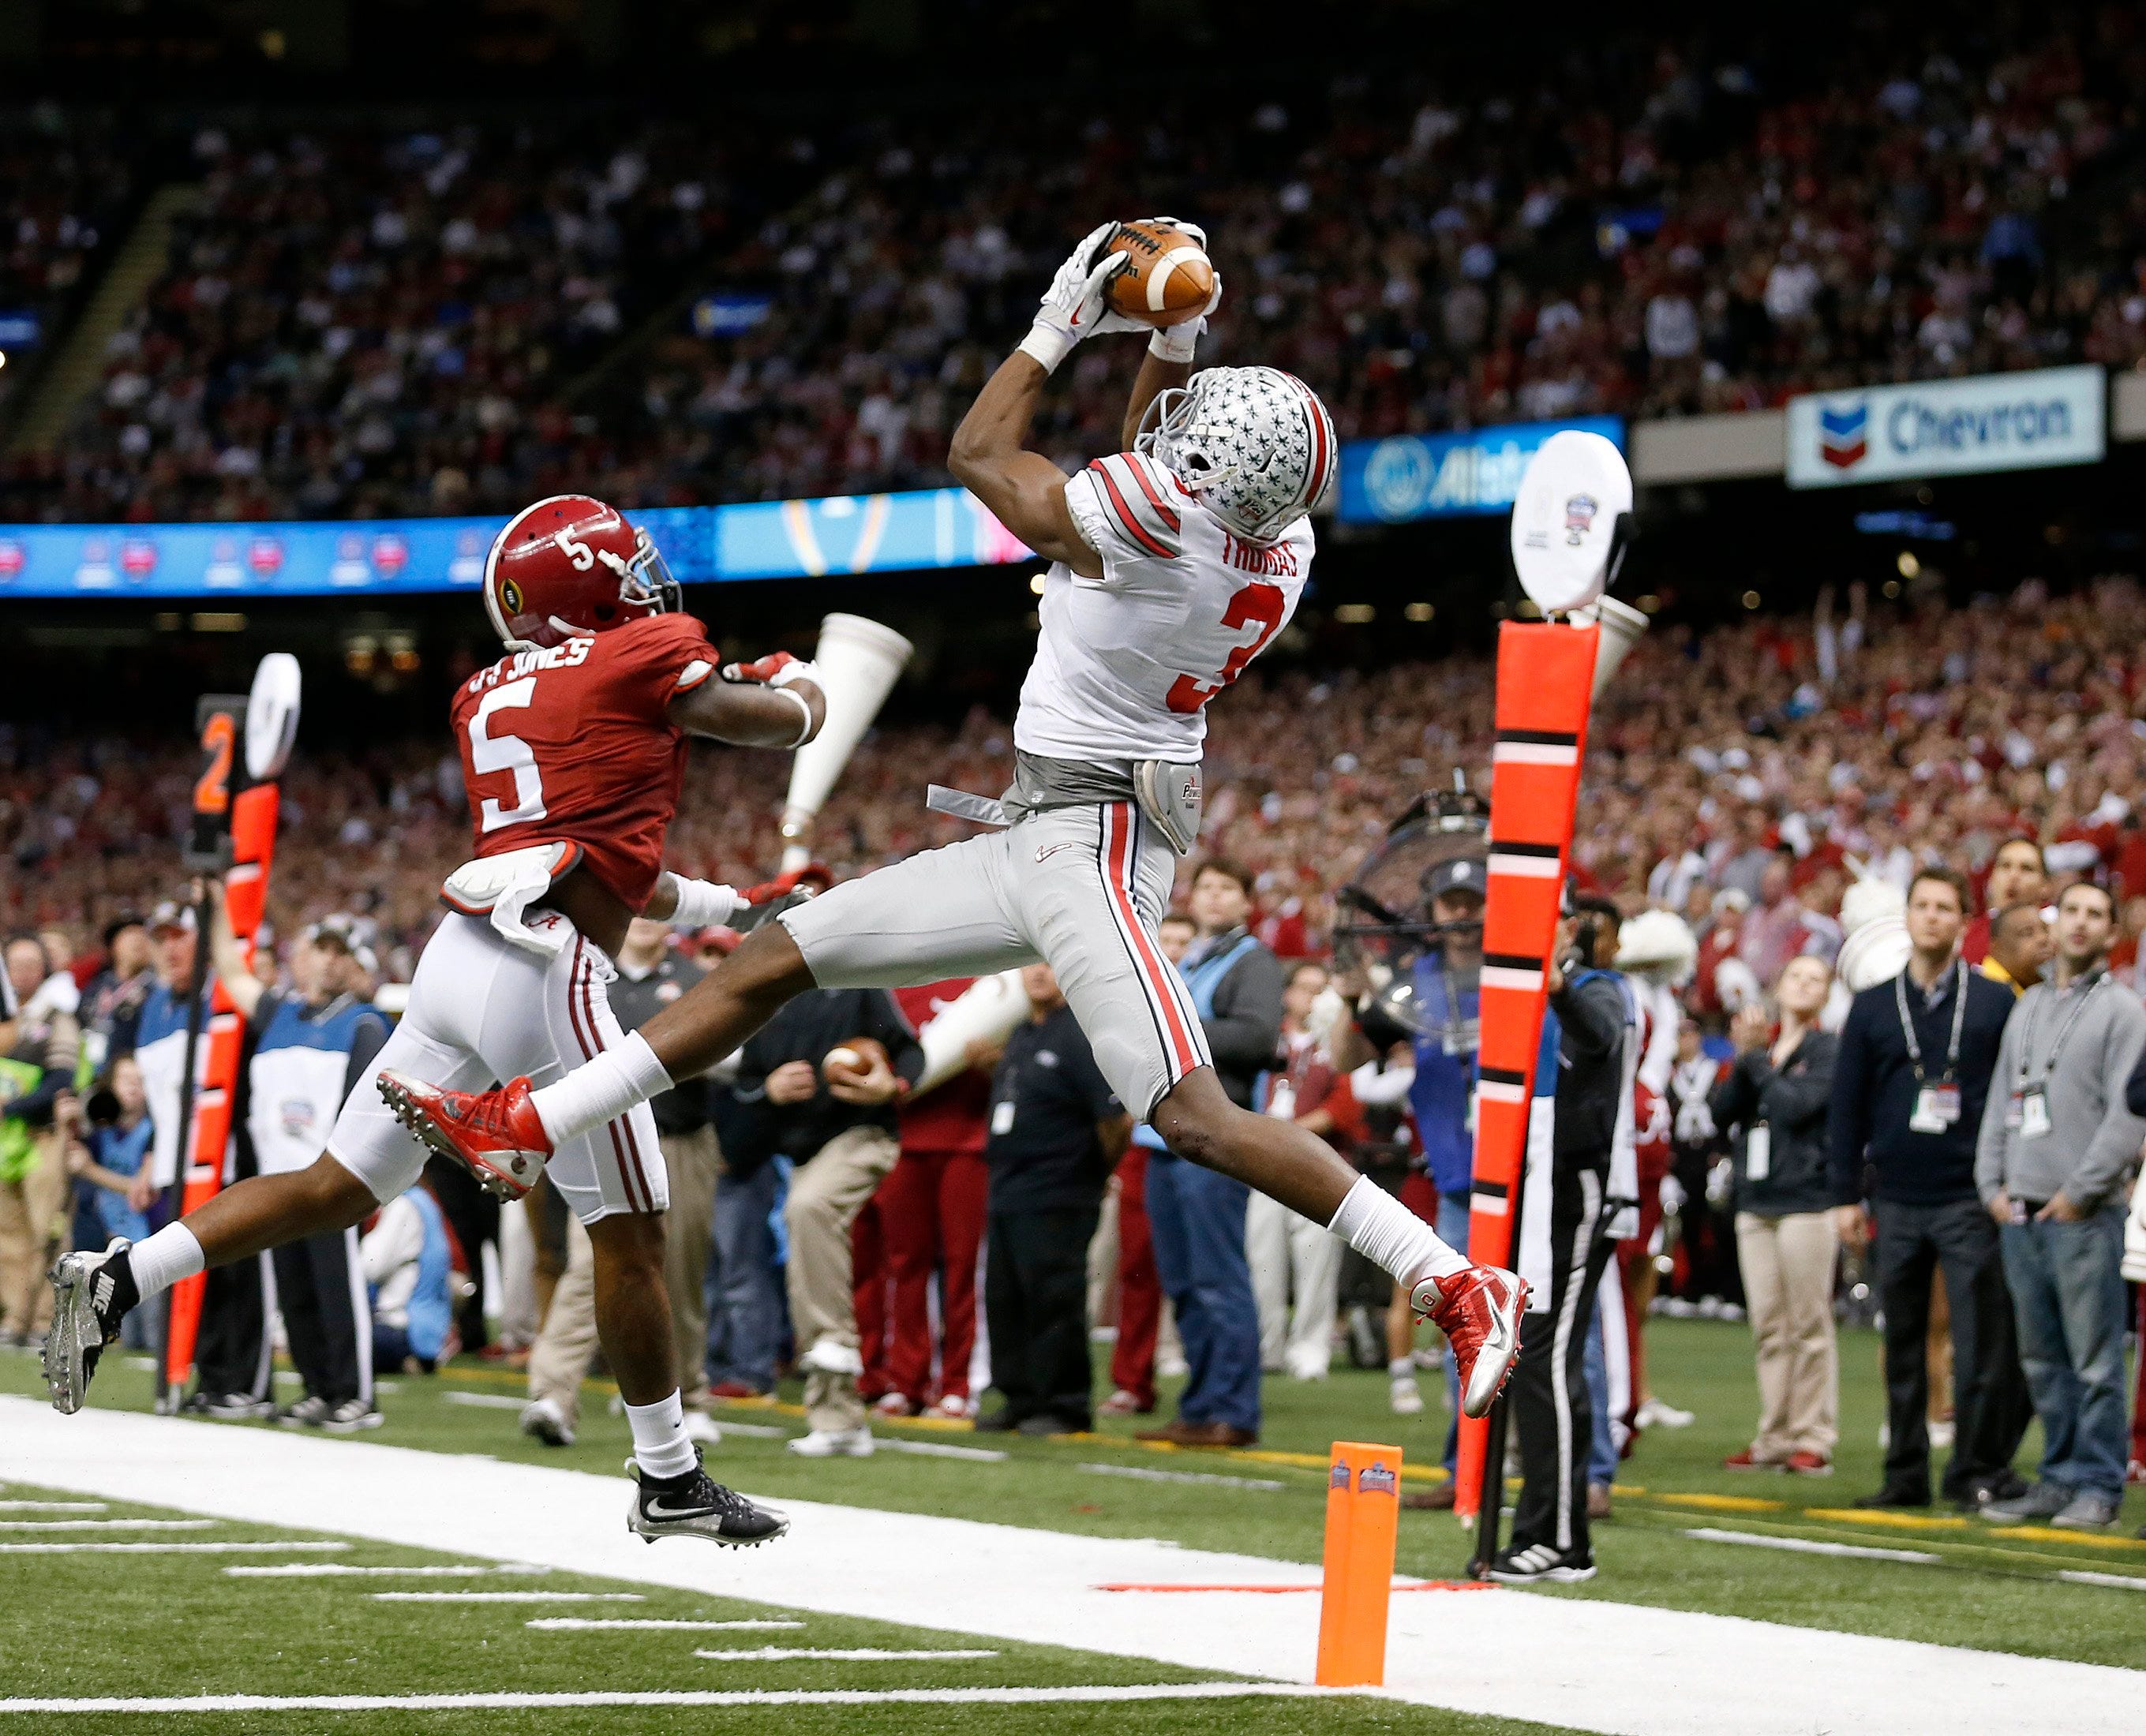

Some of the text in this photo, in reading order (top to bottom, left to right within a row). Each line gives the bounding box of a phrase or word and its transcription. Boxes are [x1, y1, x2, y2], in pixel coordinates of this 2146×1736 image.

[1888, 397, 2073, 455] Chevron
[553, 523, 595, 572] 5
[1165, 582, 1286, 714] 3
[194, 712, 236, 814] 2
[467, 675, 549, 834] 5
[92, 1270, 116, 1315] NIKE
